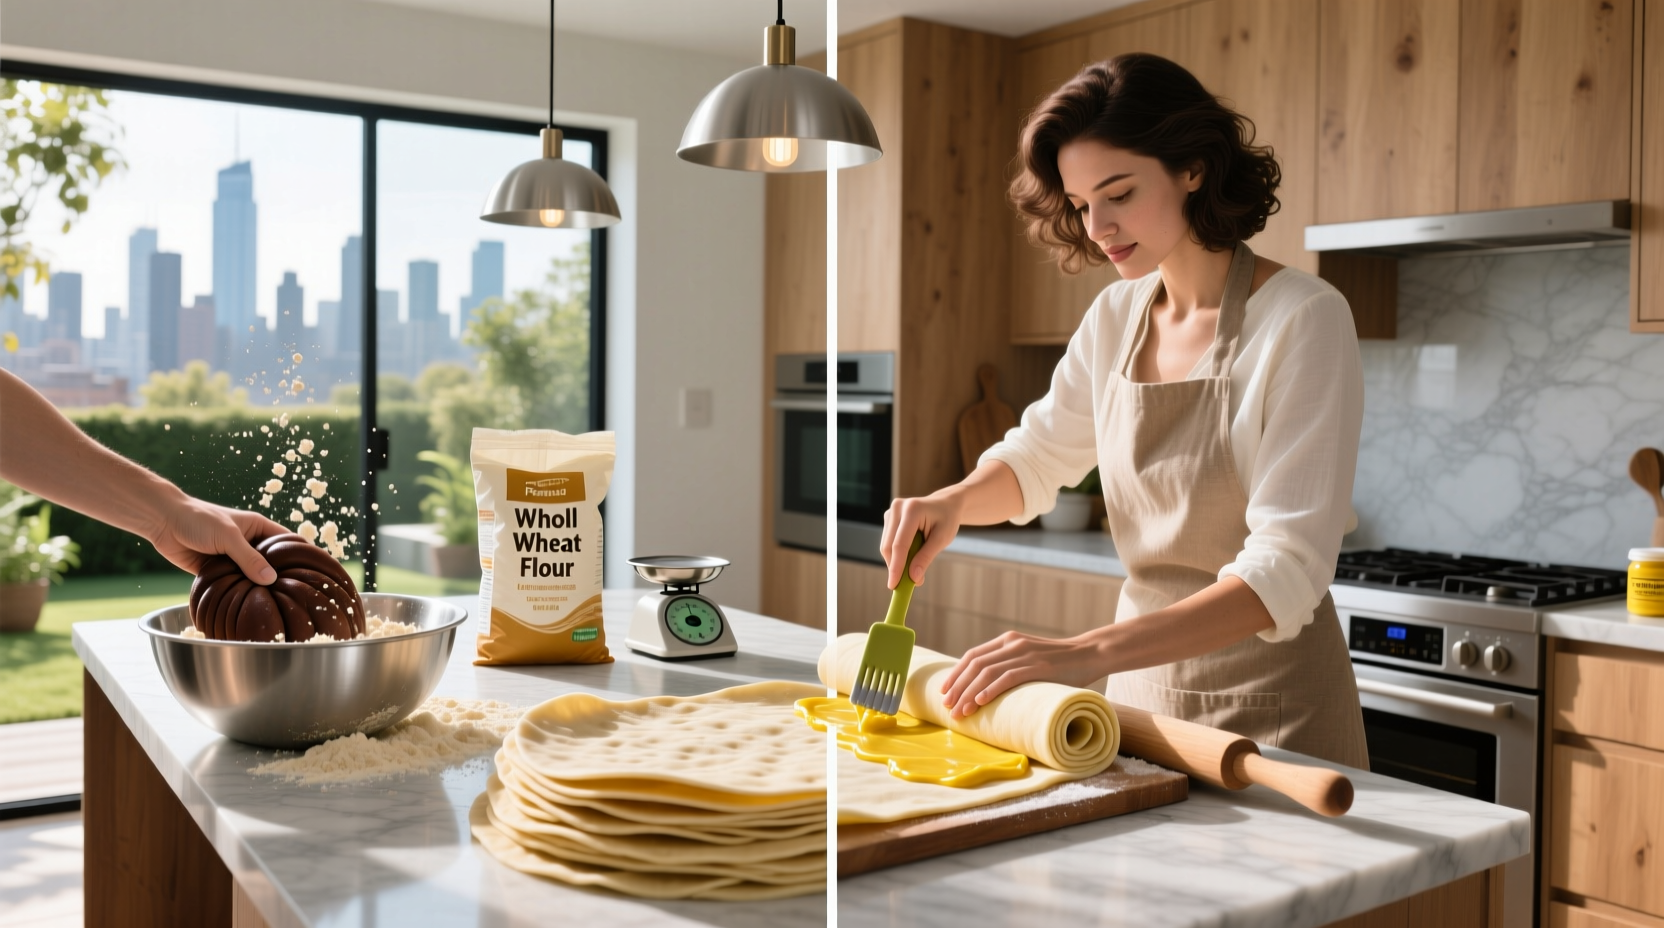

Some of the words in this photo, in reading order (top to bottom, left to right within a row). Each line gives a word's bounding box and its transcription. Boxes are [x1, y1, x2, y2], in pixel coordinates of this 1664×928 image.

[514, 507, 577, 529] Wholl
[512, 532, 582, 553] Wheat
[520, 557, 575, 577] Flour
